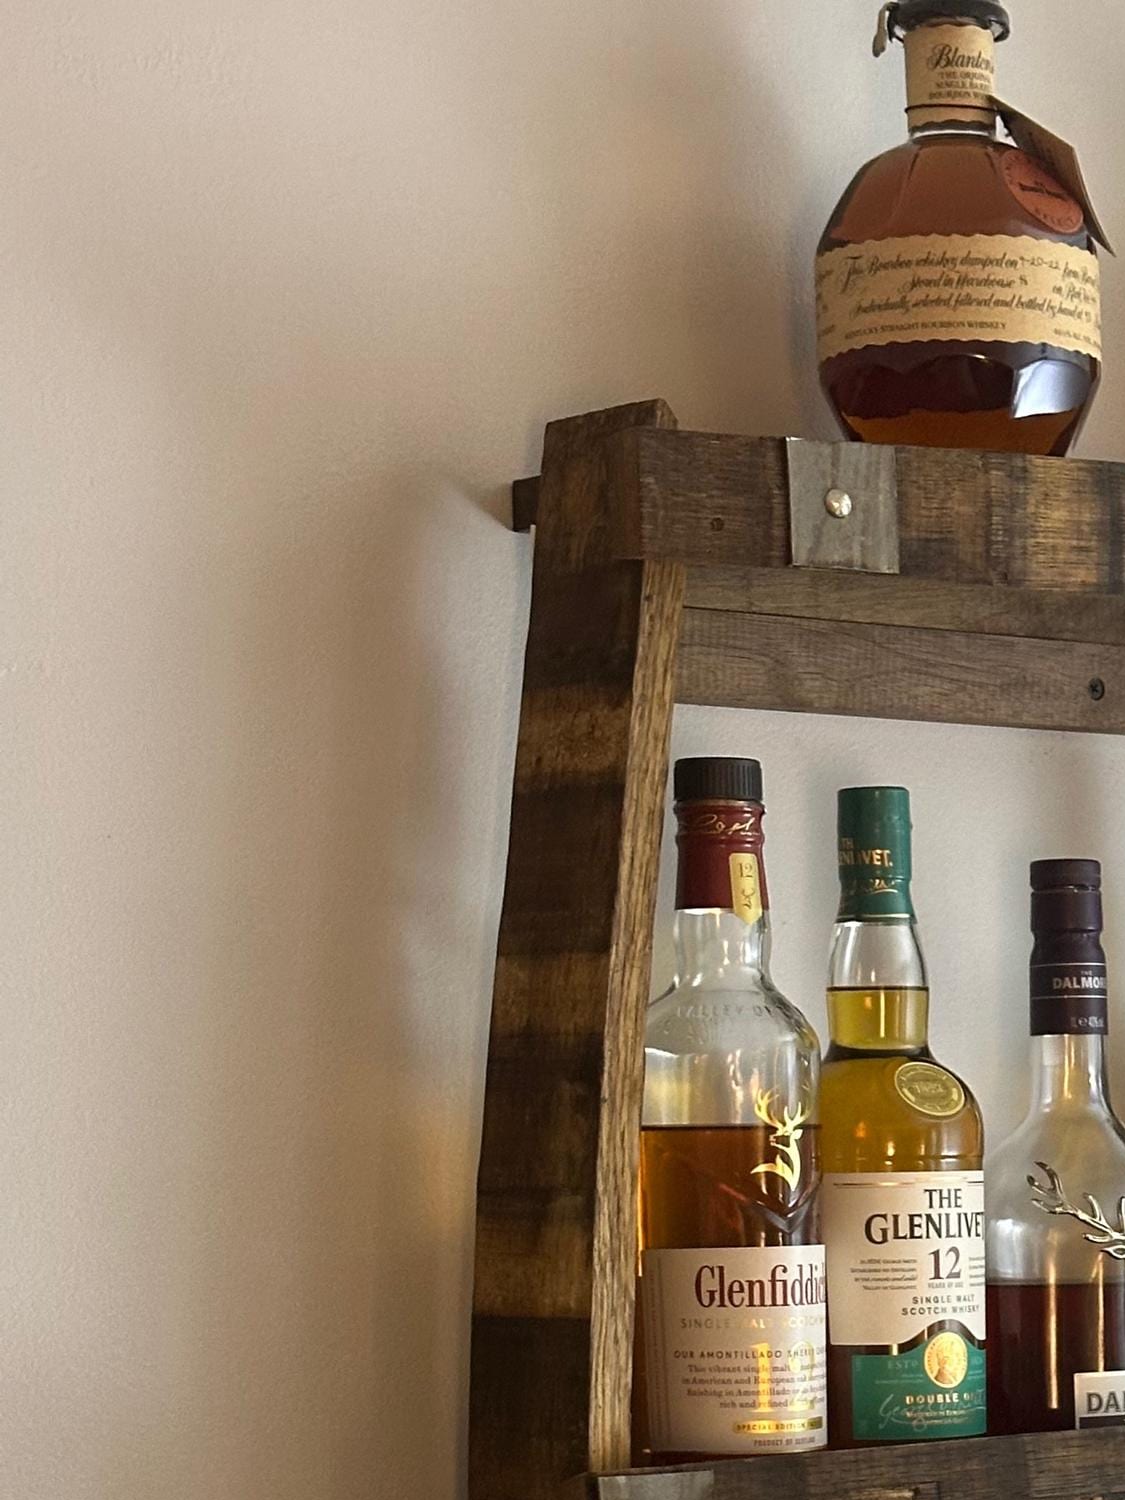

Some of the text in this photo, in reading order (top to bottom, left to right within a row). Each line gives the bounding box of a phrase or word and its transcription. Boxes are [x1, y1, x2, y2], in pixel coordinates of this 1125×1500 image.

[924, 1189, 962, 1209] THE
[928, 1246, 961, 1281] 12
[912, 1294, 975, 1305] SINGLE MALT
[901, 1304, 980, 1317] SCOTCH WHISKY
[680, 1318, 730, 1330] SINGLE
[674, 1349, 783, 1360] OUR AMONTILLADO
[906, 1391, 959, 1405] DOUBLE
[737, 1420, 772, 1432] SPECIAL
